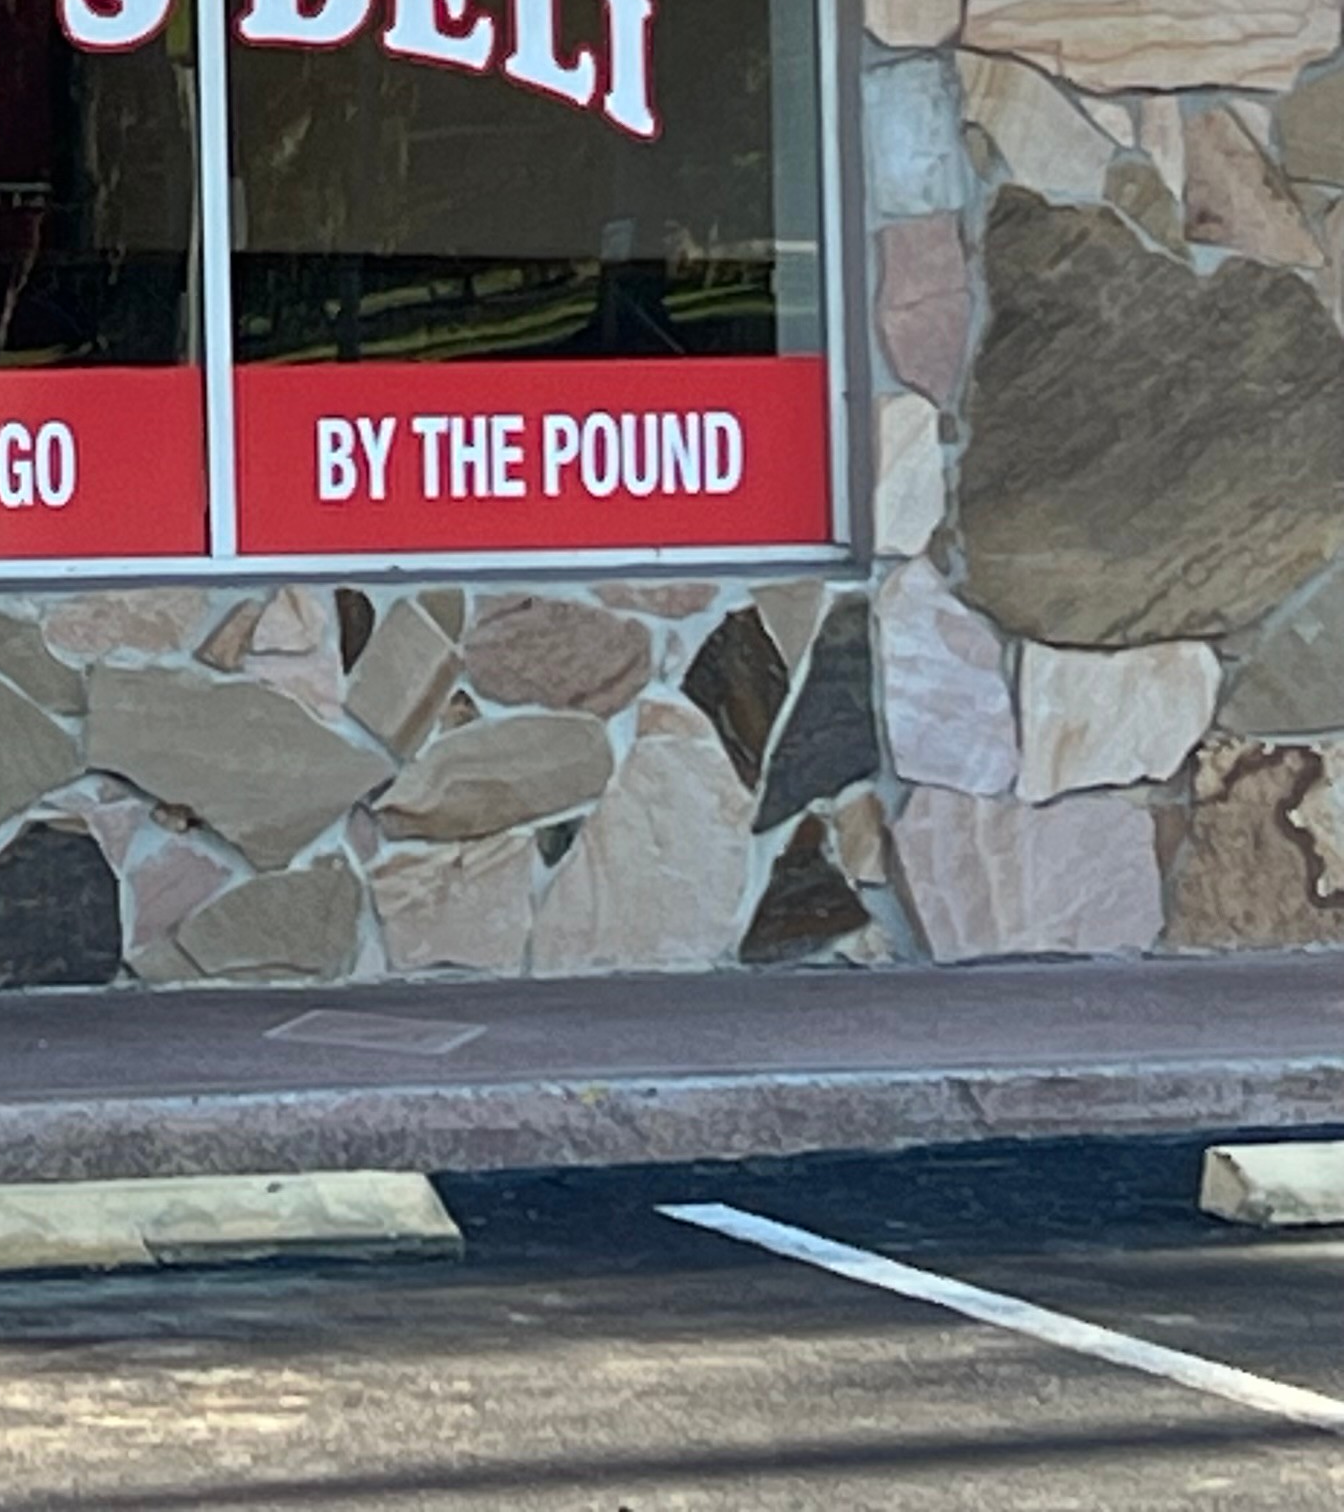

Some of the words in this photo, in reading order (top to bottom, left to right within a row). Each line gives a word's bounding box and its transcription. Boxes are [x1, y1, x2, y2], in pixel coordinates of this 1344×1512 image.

[316, 417, 396, 500] BY
[411, 414, 526, 498] THE
[542, 411, 744, 497] POUND
